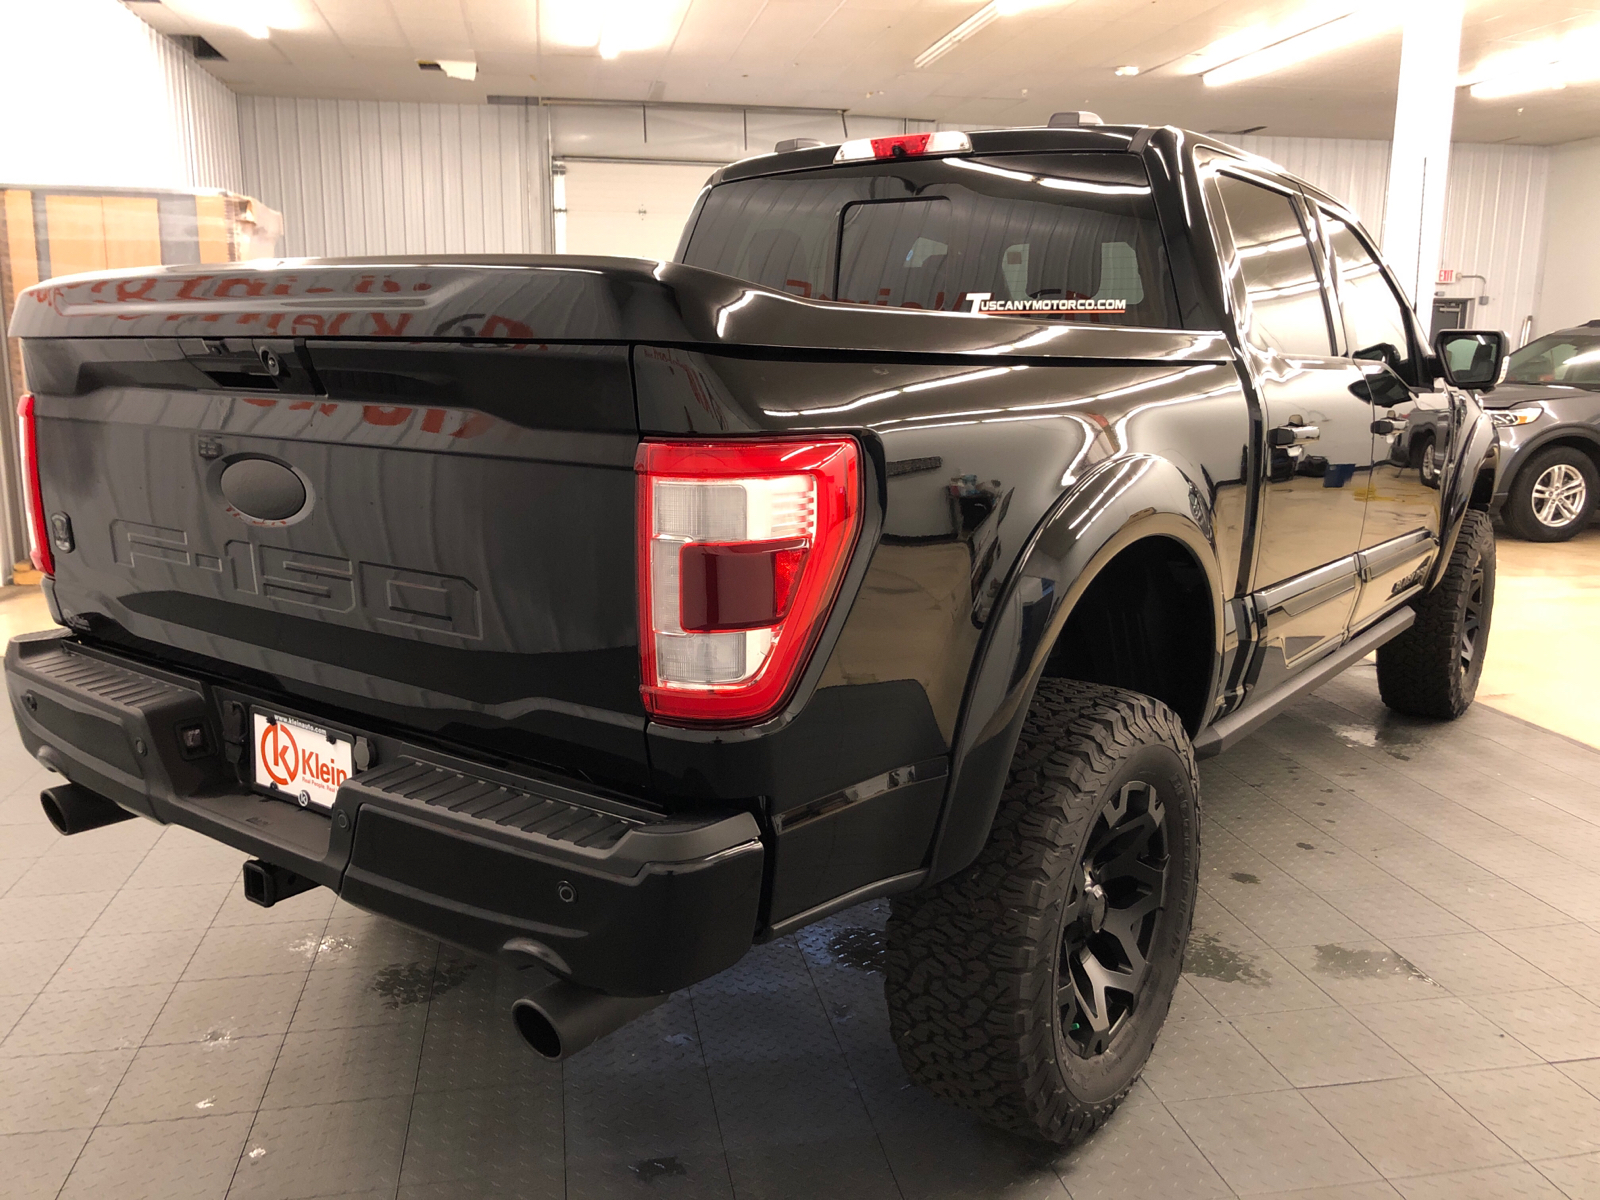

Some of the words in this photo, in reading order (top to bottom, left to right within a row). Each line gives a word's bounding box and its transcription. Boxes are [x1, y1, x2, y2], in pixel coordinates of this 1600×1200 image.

[1439, 270, 1453, 281] EXIT
[109, 518, 483, 641] F-150
[301, 748, 347, 787] Klein
